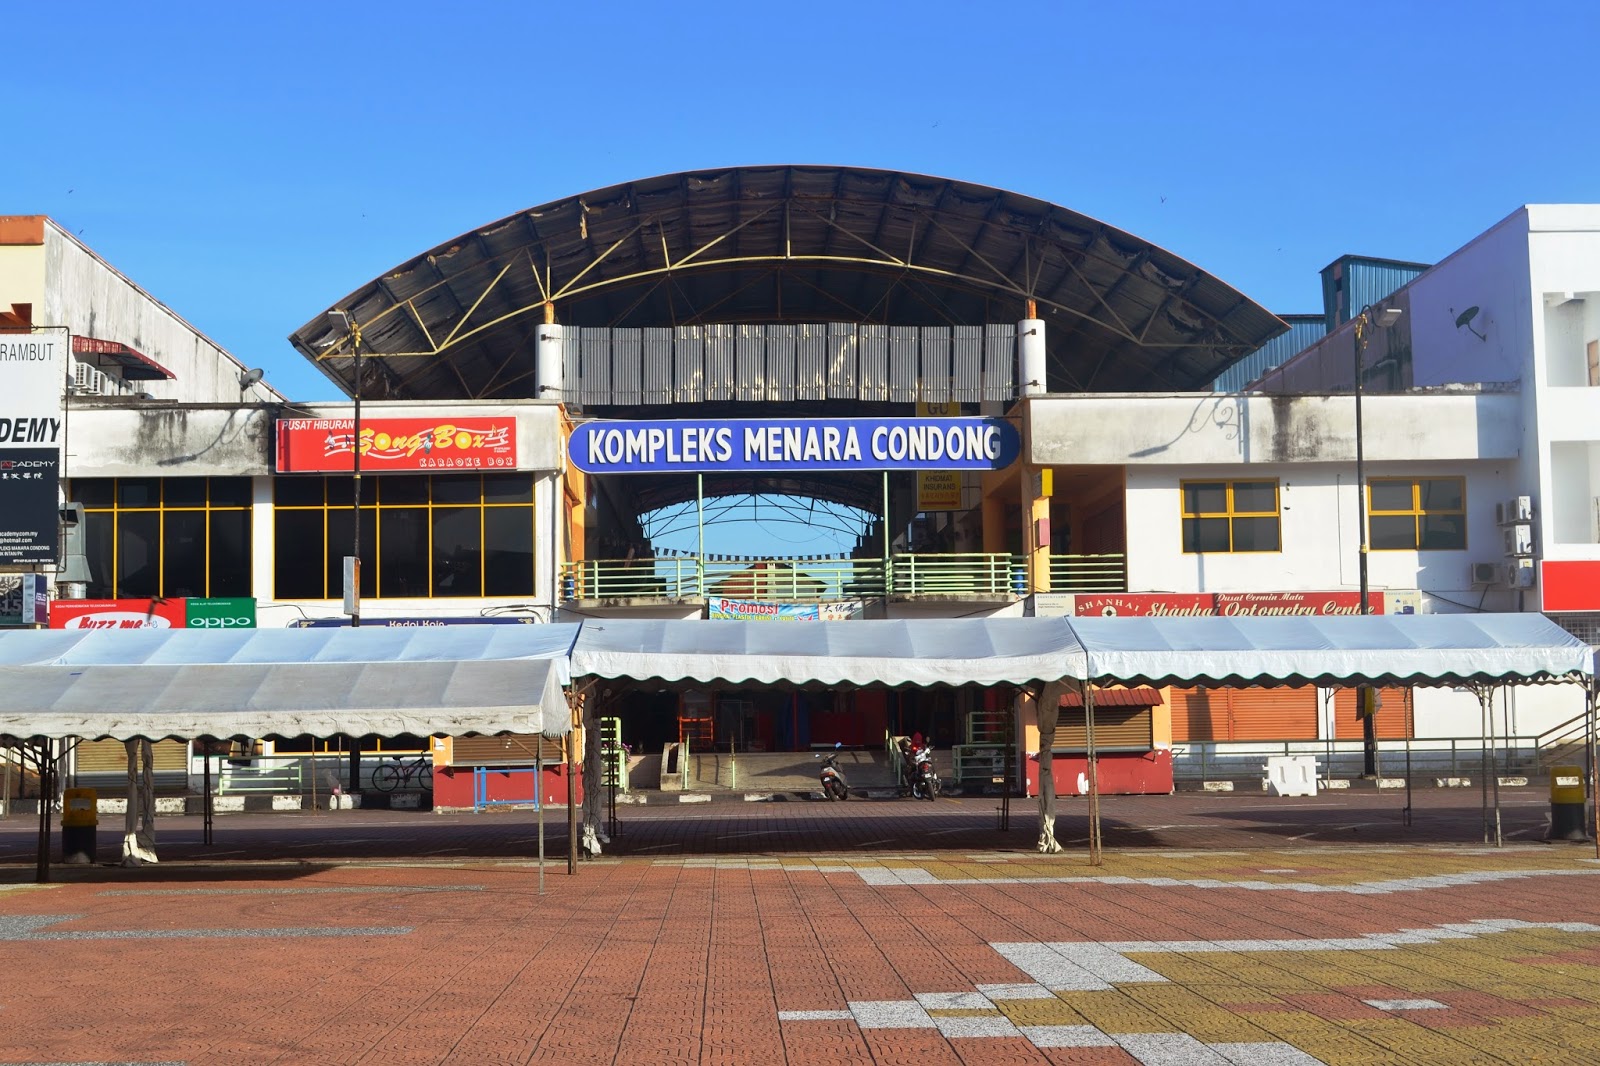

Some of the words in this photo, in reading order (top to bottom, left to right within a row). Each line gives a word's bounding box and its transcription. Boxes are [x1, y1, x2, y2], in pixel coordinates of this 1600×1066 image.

[0, 343, 54, 361] RAMBUT
[0, 418, 60, 443] DEMY
[281, 420, 312, 430] PUSAT
[313, 420, 355, 430] HIBURAN
[587, 427, 732, 464] KOMPLEKS
[744, 426, 863, 462] MENARA
[871, 425, 1001, 461] CONDONG
[419, 457, 481, 467] KARAOKE
[487, 456, 514, 466] BOX
[923, 483, 956, 491] INSURANS
[1217, 593, 1244, 603] Pusat
[1245, 593, 1278, 602] Cermin
[1279, 592, 1305, 601] Mata
[720, 599, 779, 615] Promosi
[1078, 598, 1139, 613] SHANHAI
[1145, 602, 1221, 617] Shanhai
[1224, 602, 1317, 617] Optometry
[1322, 600, 1376, 616] Cente
